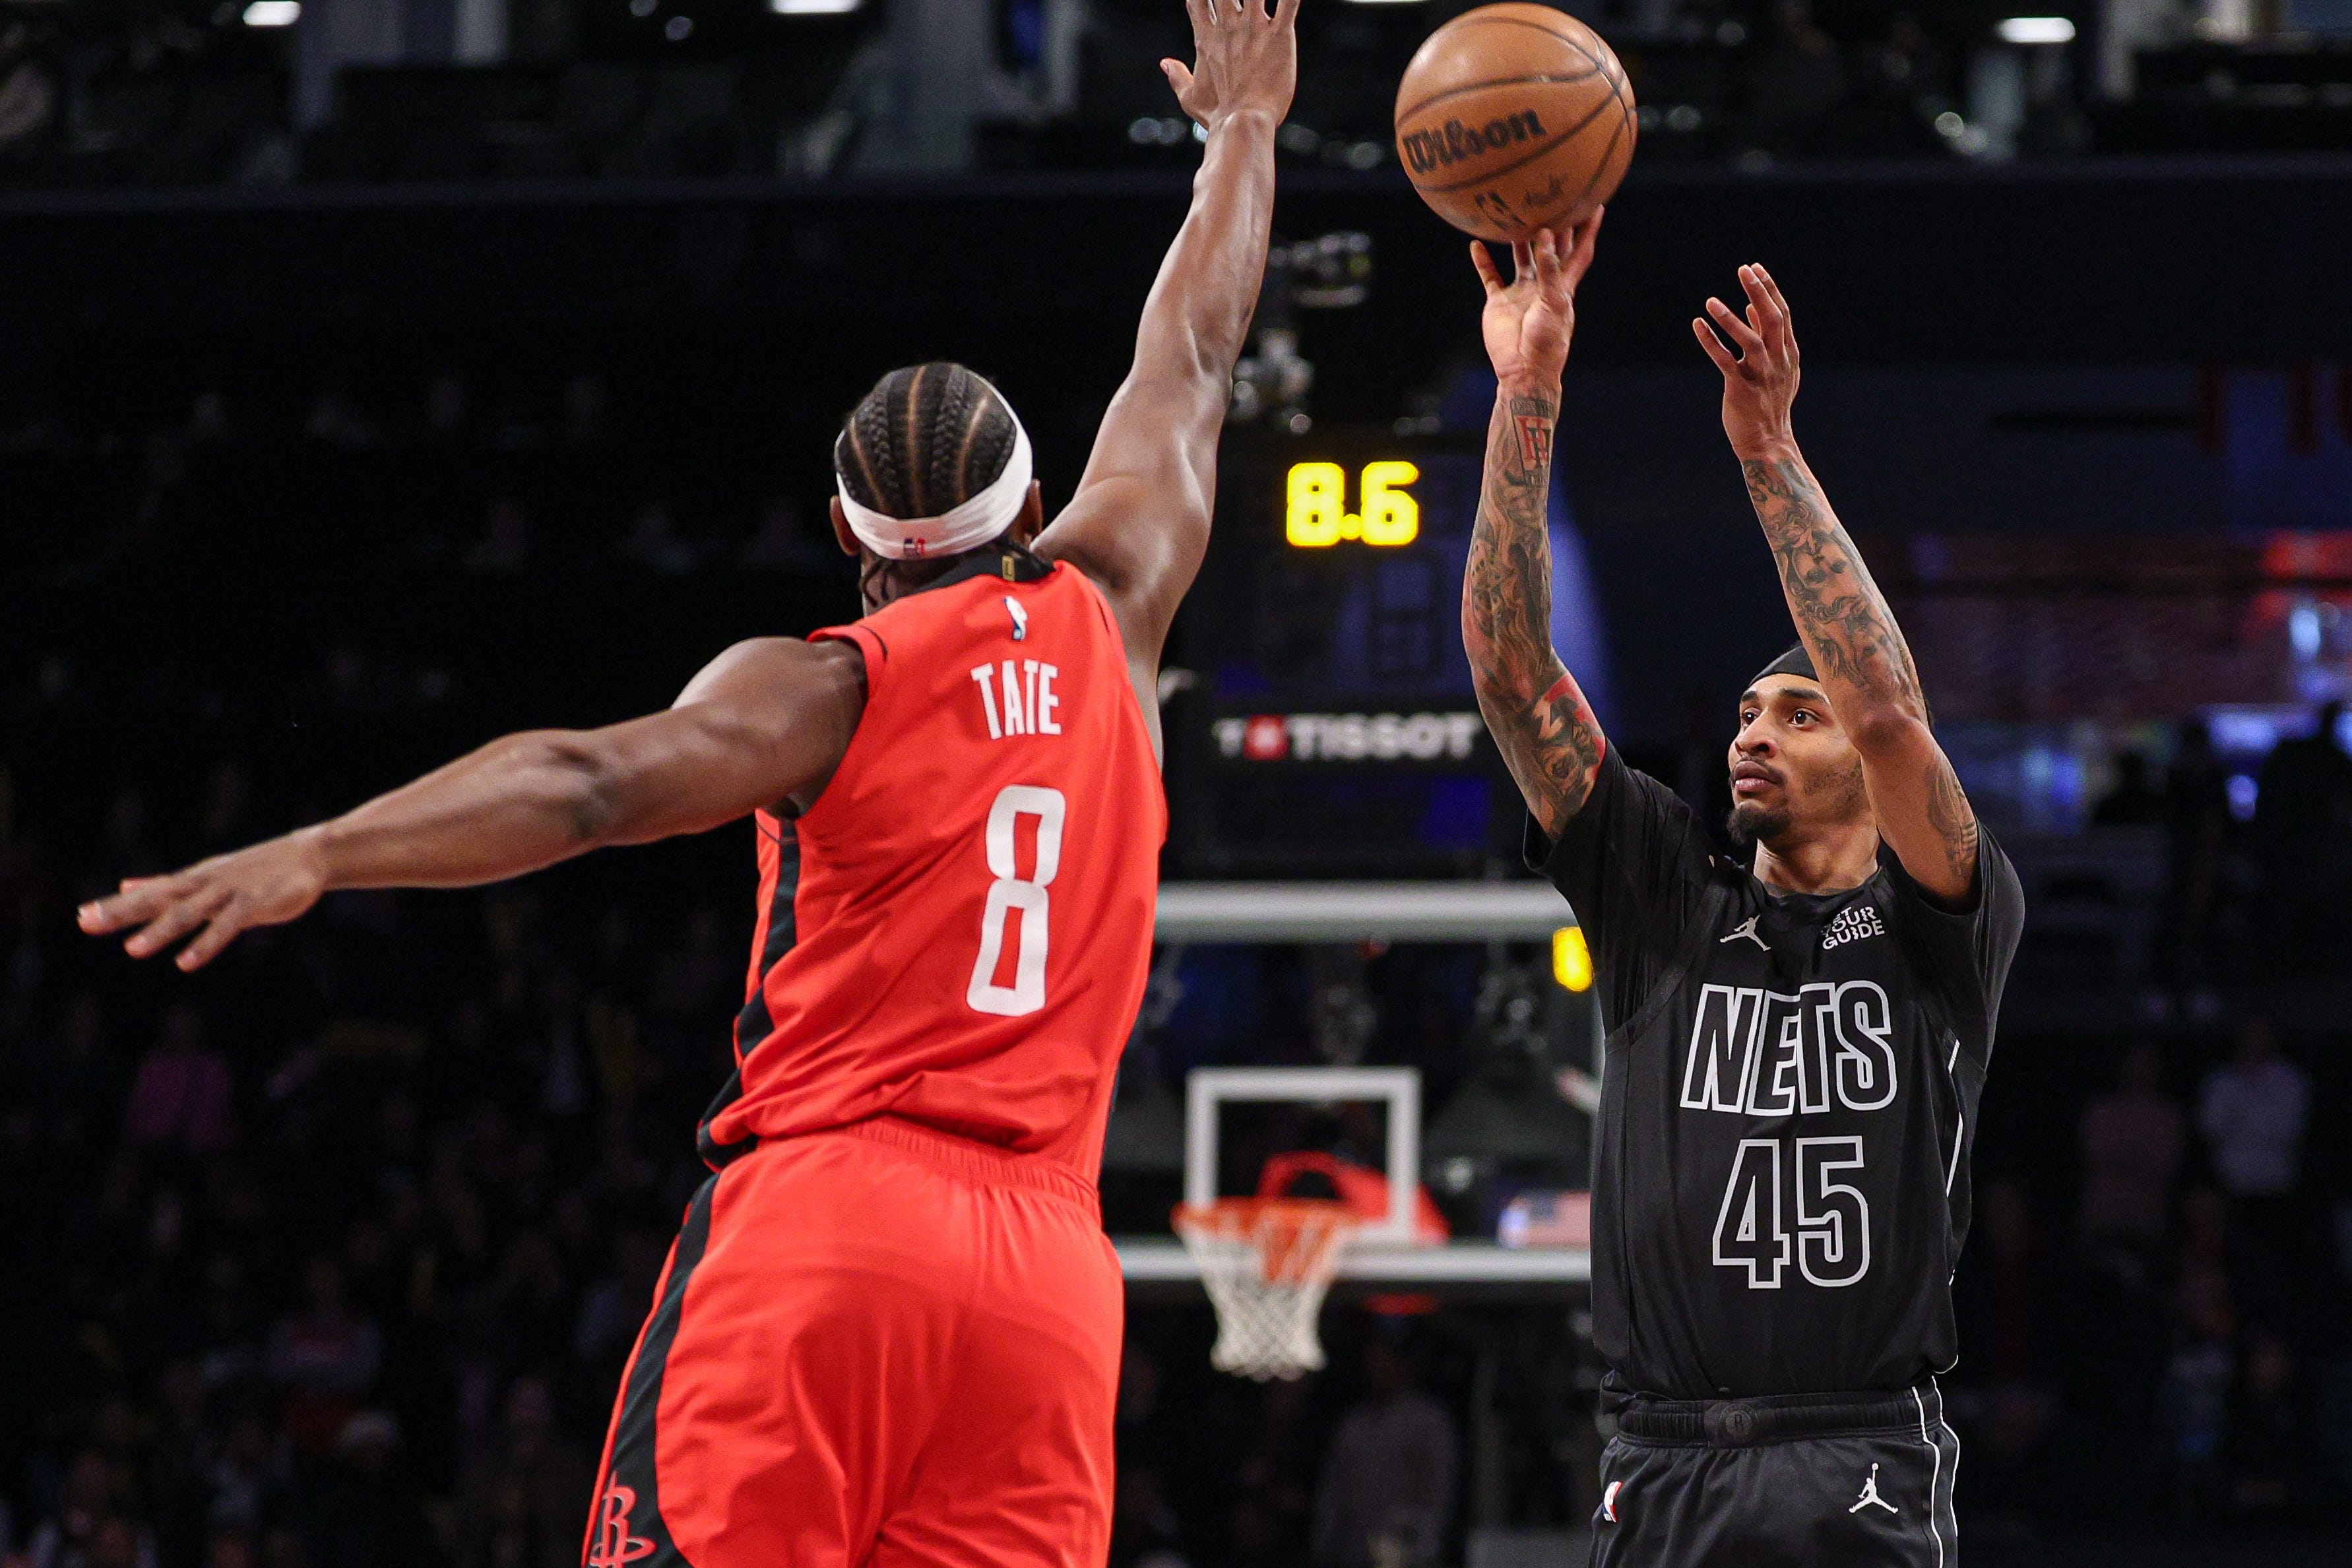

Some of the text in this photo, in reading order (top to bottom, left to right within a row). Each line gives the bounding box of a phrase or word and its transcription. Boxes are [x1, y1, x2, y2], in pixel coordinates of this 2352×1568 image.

[1403, 108, 1546, 174] Wilson
[1287, 461, 1419, 546] 8.6
[970, 659, 1063, 739] TATE
[966, 784, 1066, 1017] 8
[1822, 919, 1886, 950] GUIDE
[1680, 980, 1897, 1116] NETS
[1713, 1135, 1870, 1290] 45
